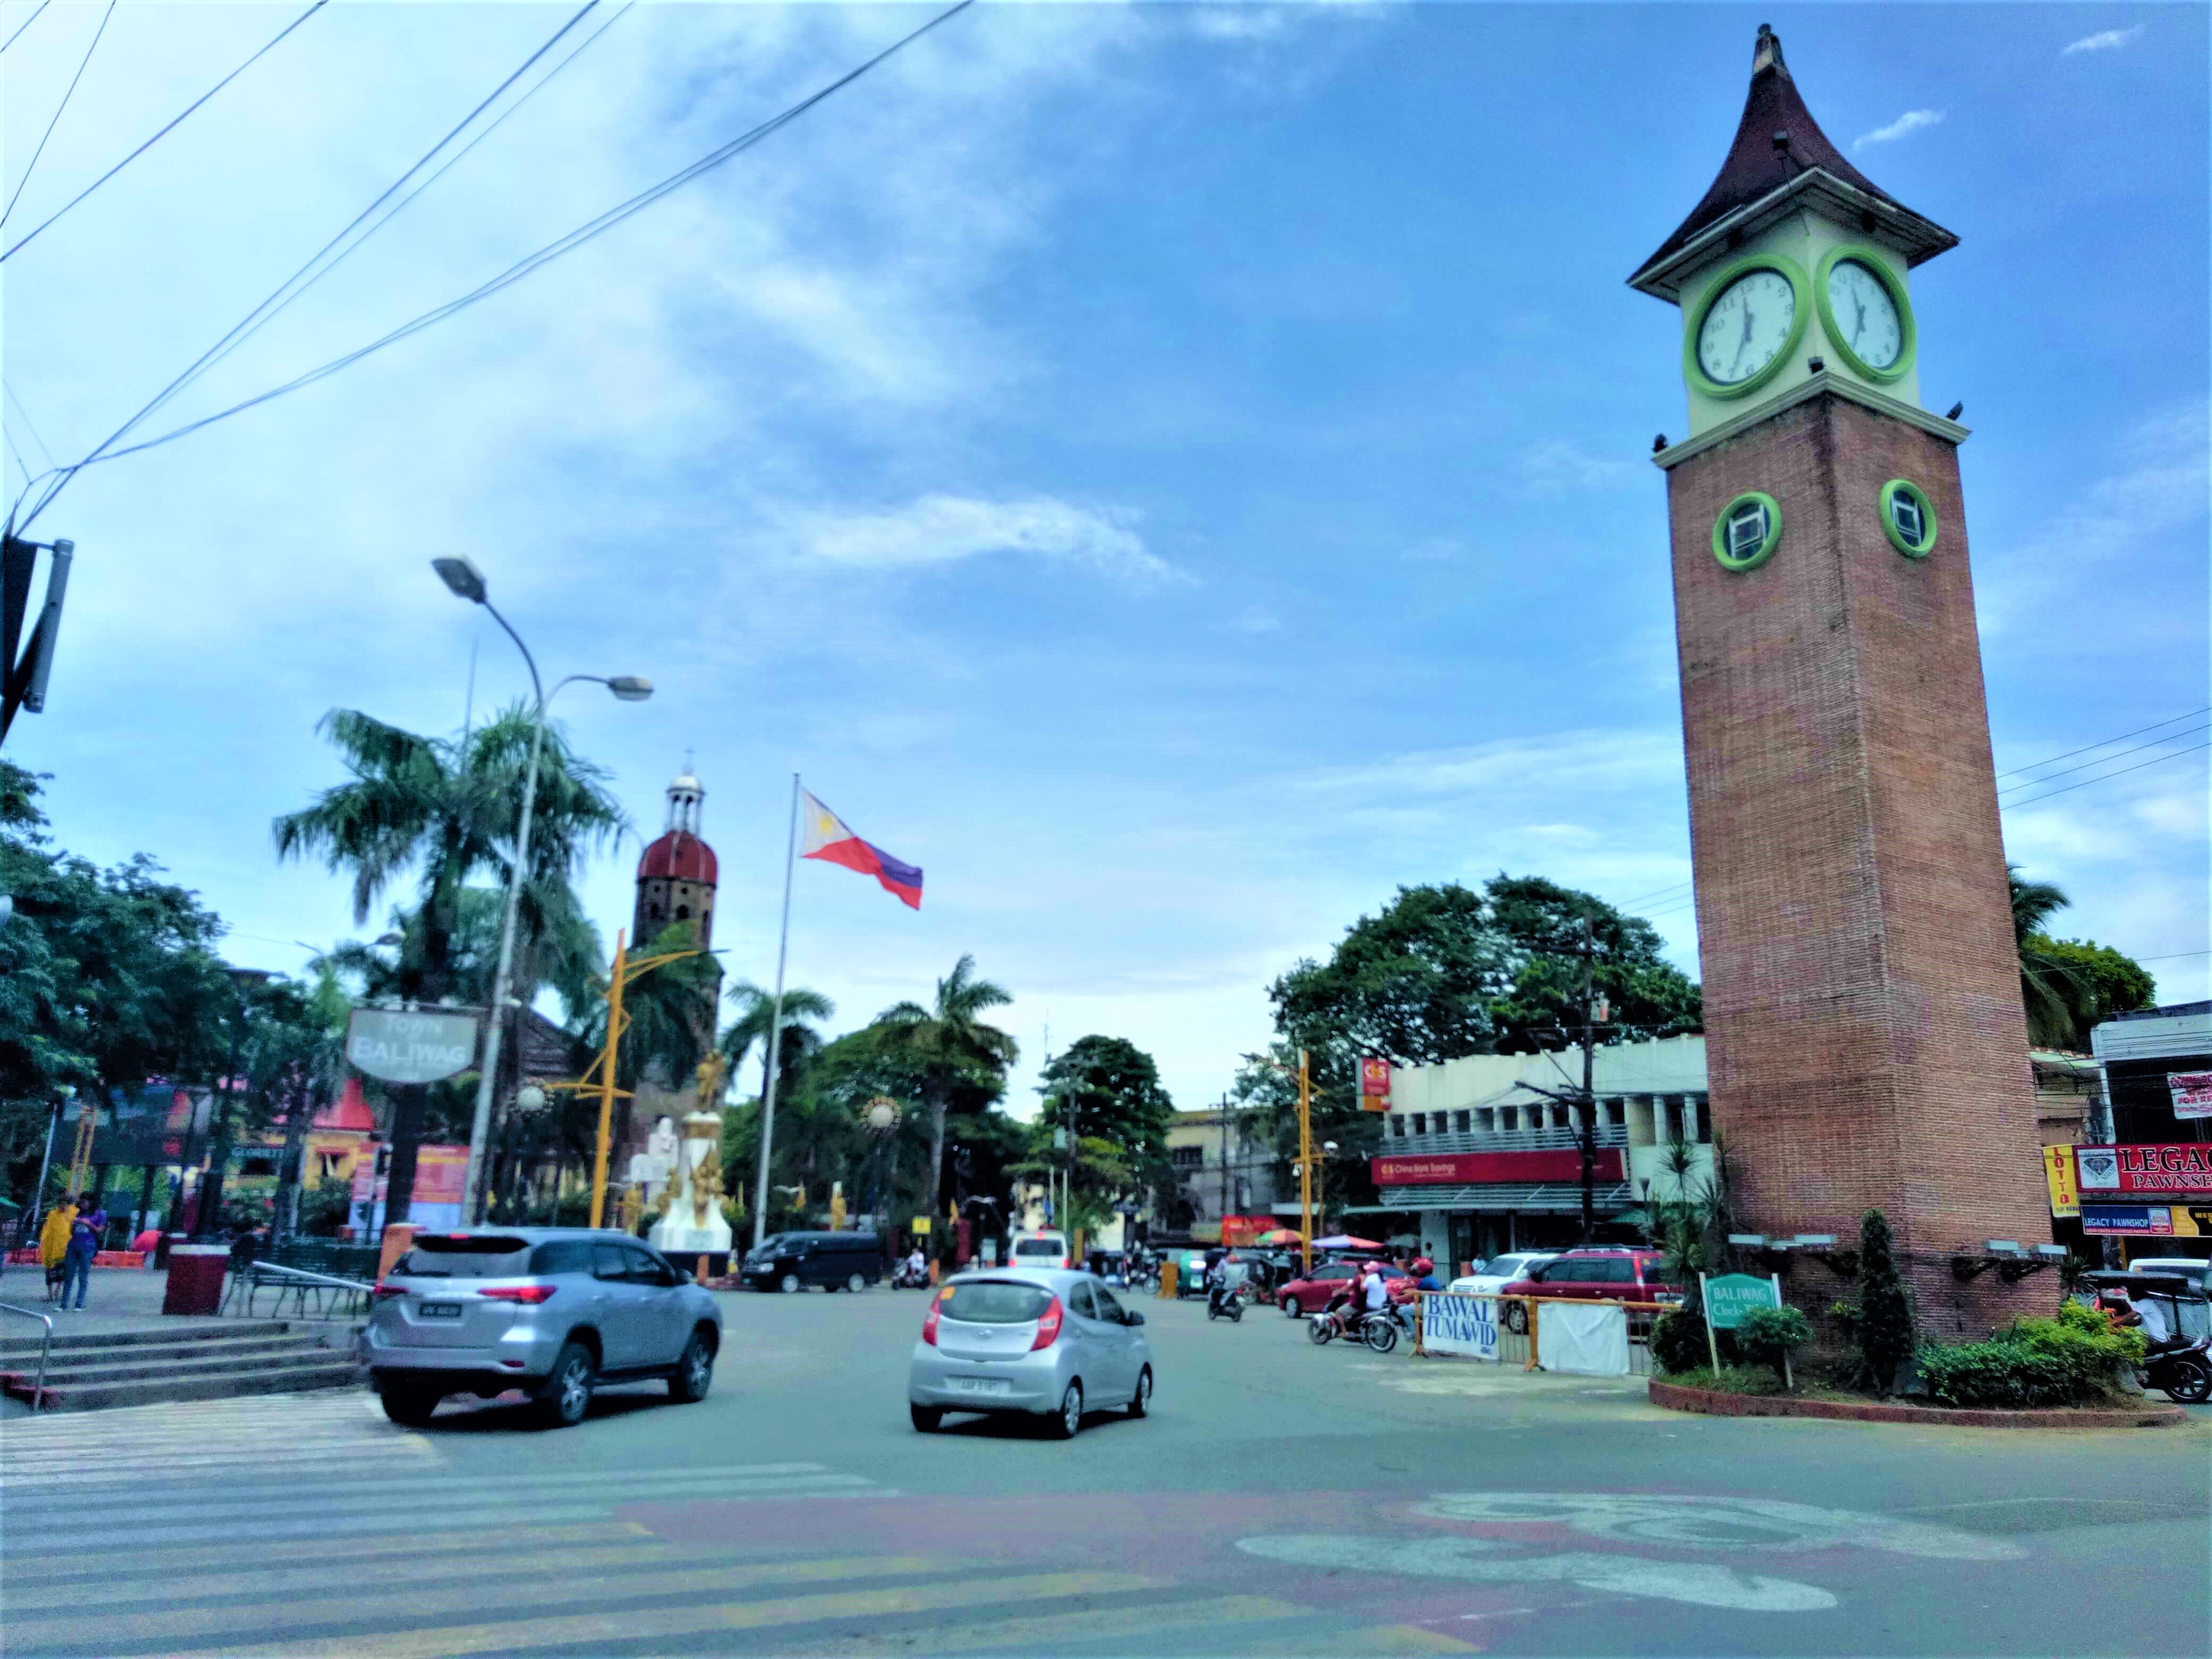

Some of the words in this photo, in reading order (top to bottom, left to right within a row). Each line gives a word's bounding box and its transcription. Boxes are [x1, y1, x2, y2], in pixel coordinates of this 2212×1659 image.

[1778, 286, 1787, 299] 2
[1722, 297, 1736, 313] 11
[1710, 319, 1725, 334] 10
[1706, 341, 1715, 354] 9
[2084, 1217, 2109, 1227] LEGACY
[2112, 1218, 2148, 1228] PAWNSHOP
[1713, 1287, 1767, 1301] BALIWAG
[1427, 1294, 1494, 1323] BAWAL
[1425, 1315, 1497, 1345] TUMAWID
